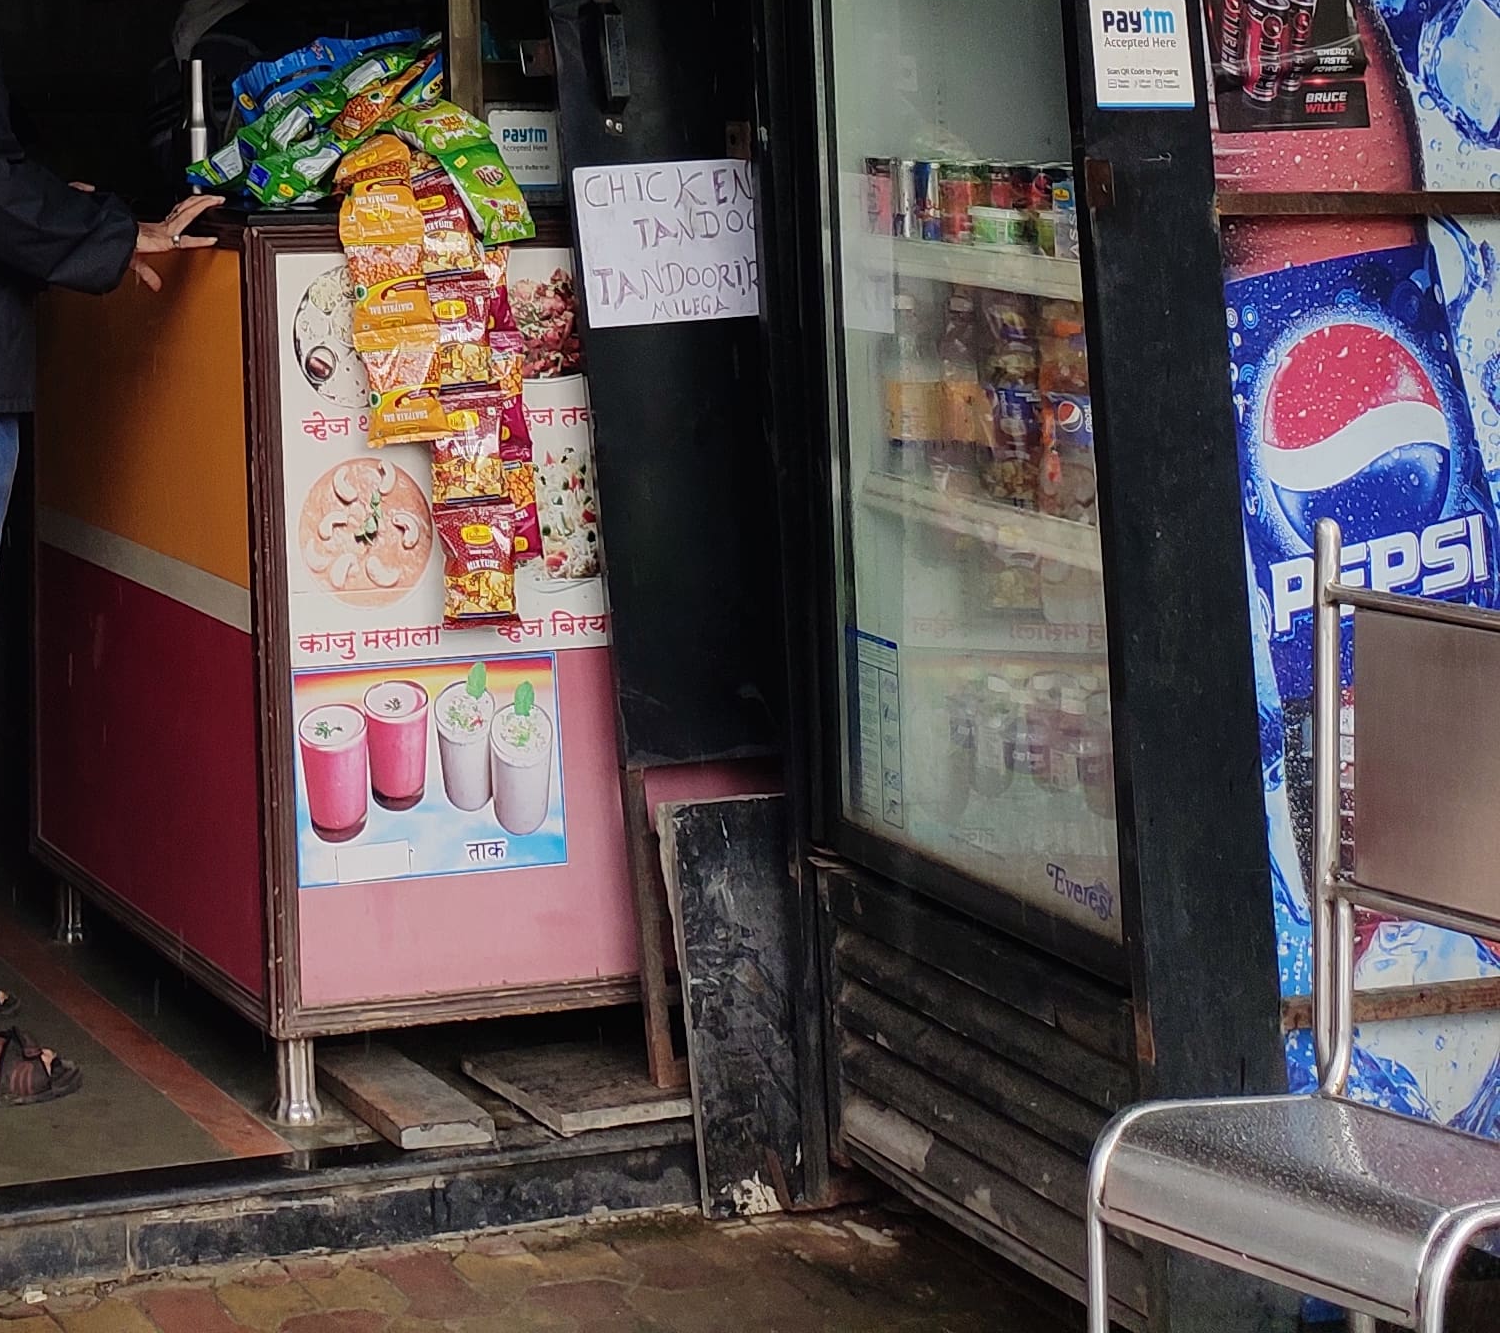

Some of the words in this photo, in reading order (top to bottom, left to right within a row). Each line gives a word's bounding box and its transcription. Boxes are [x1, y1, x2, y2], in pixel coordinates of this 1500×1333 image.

[1104, 37, 1150, 50] Accepted
[1152, 37, 1177, 48] Here
[1306, 91, 1348, 103] BRUCE
[1305, 102, 1347, 114] WILLIS
[302, 412, 351, 441] व्हेज
[466, 559, 500, 571] MIXTURE
[363, 625, 441, 649] मसाला
[467, 840, 505, 861] ताक
[1046, 862, 1114, 922] Everest
